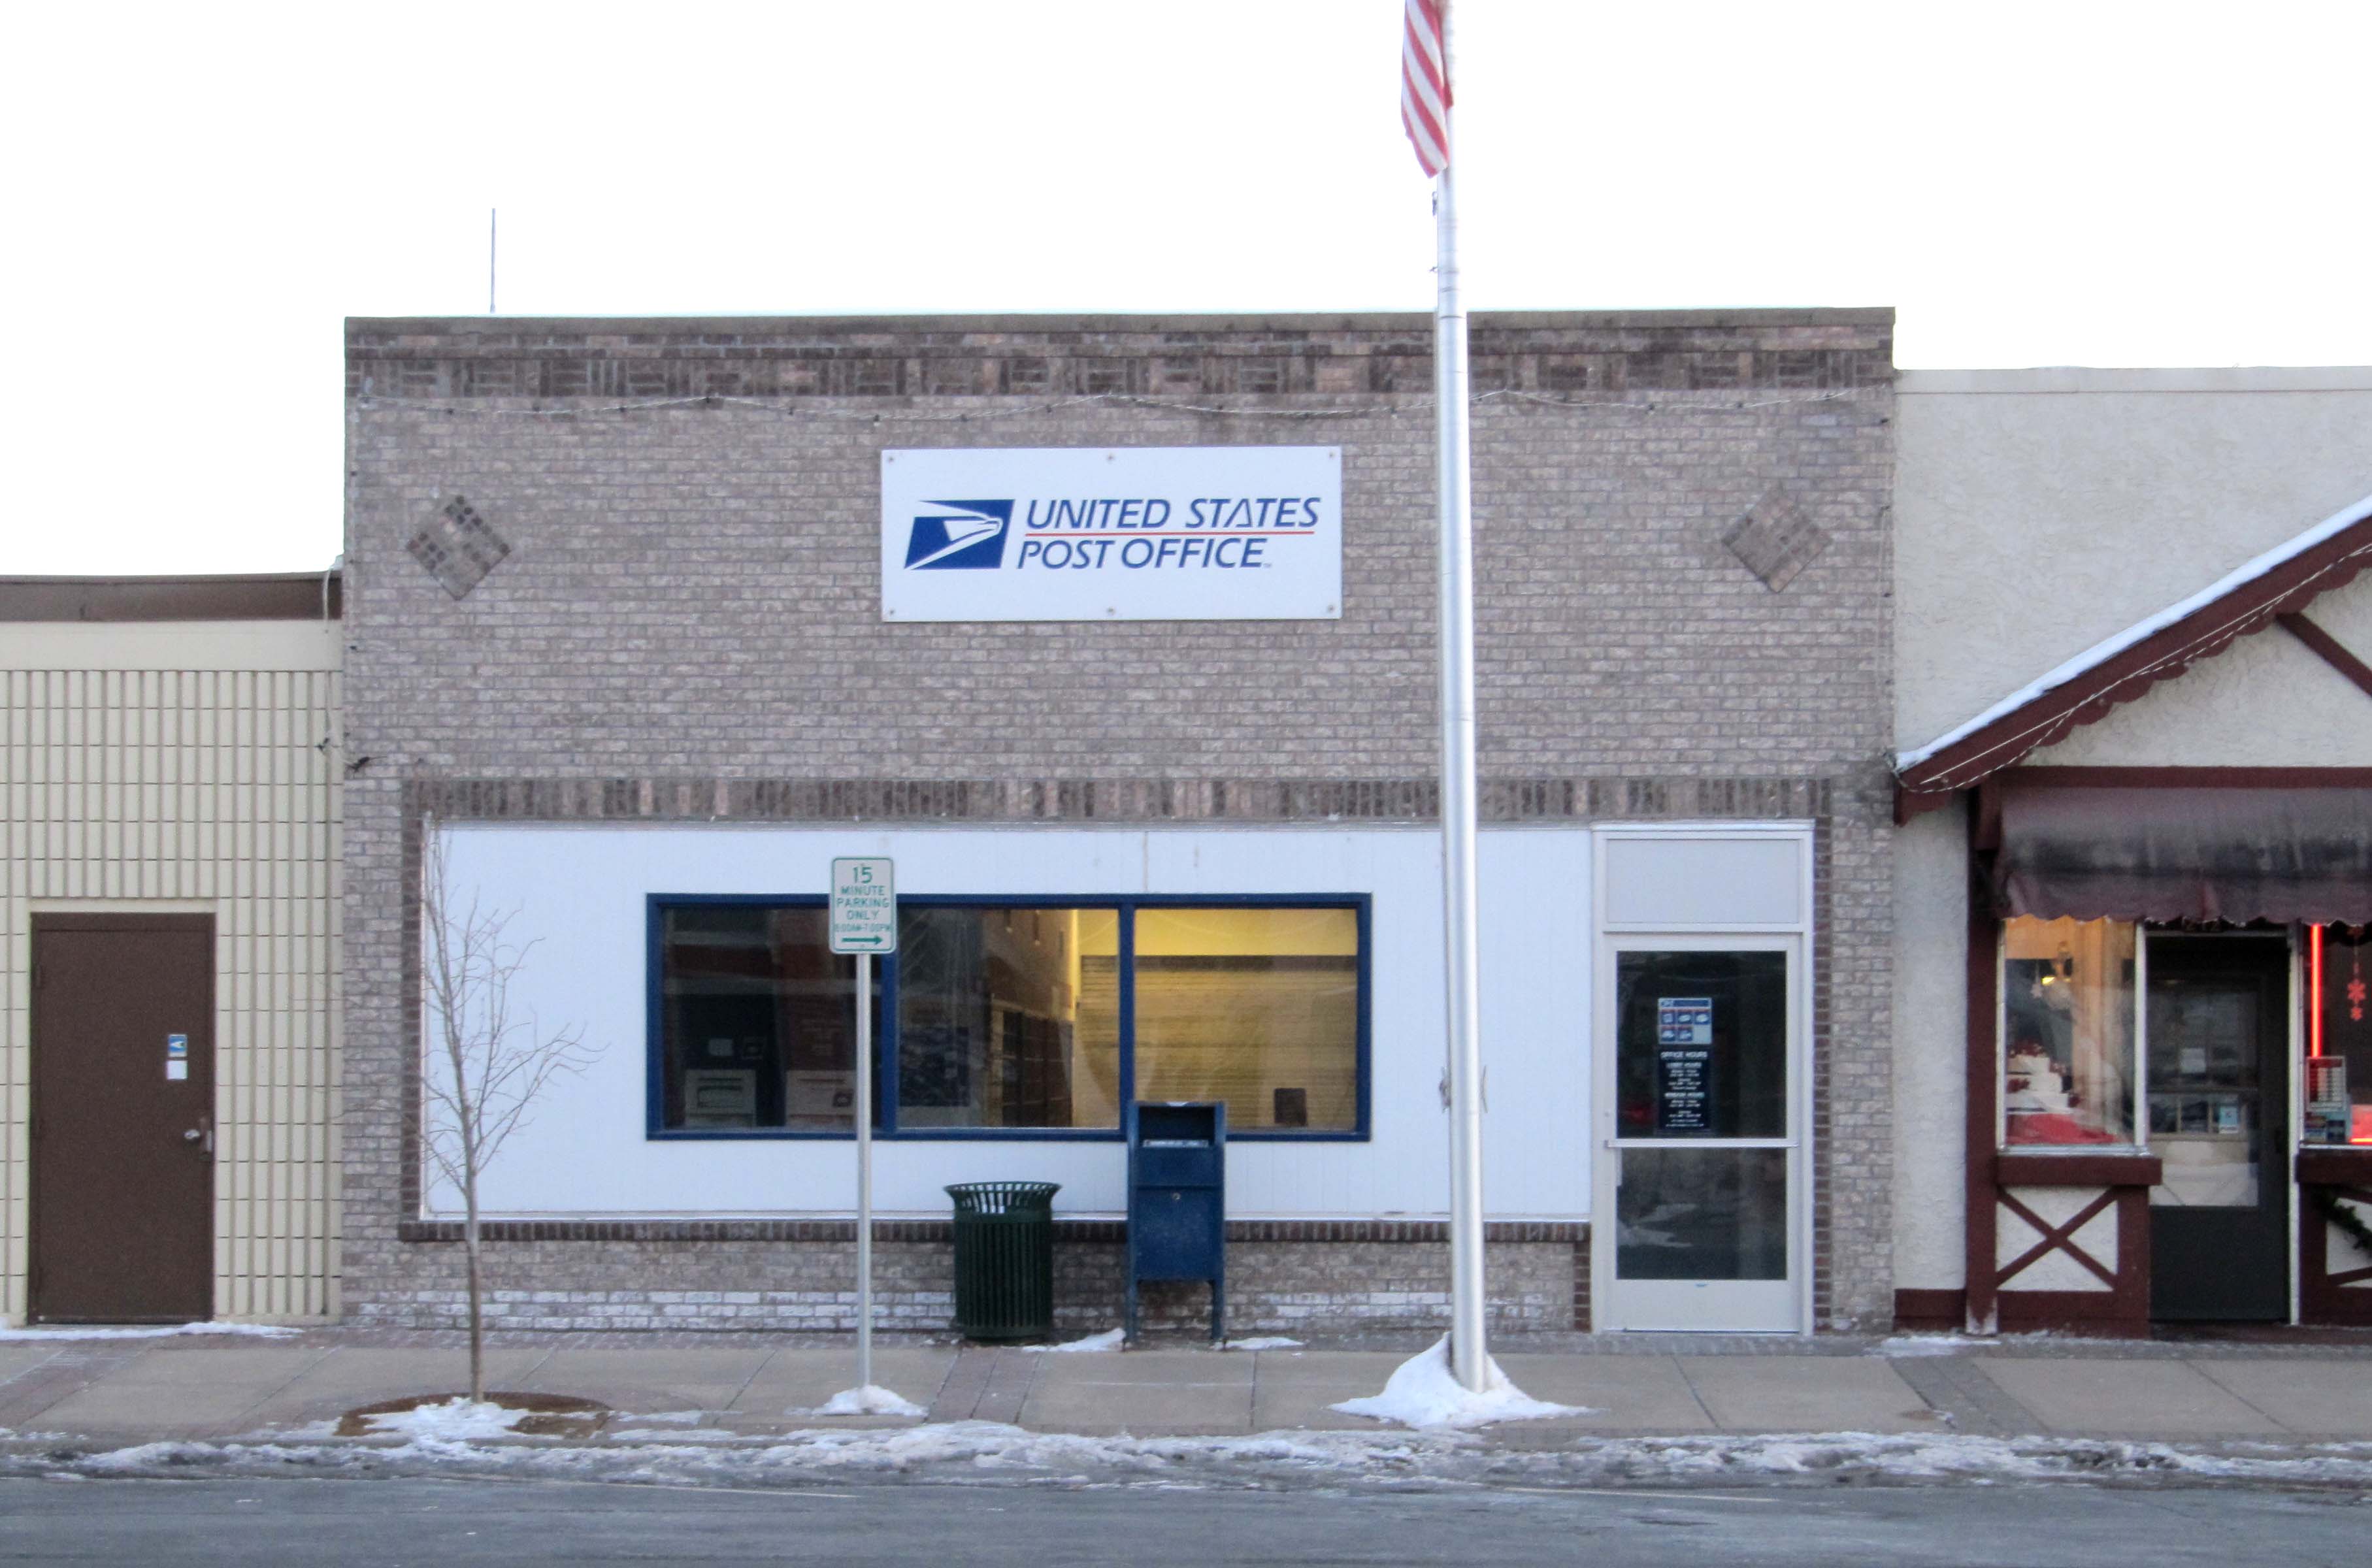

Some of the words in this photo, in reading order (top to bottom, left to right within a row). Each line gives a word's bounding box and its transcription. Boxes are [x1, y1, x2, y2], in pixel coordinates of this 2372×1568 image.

[1026, 498, 1170, 529] UNITED
[1185, 497, 1321, 528] STATES
[1017, 538, 1115, 569] POST
[1121, 537, 1268, 568] OFFICE
[853, 867, 872, 884] 15
[841, 885, 885, 896] MINUTE
[836, 898, 889, 907] PARKING
[847, 910, 879, 920] ONLY
